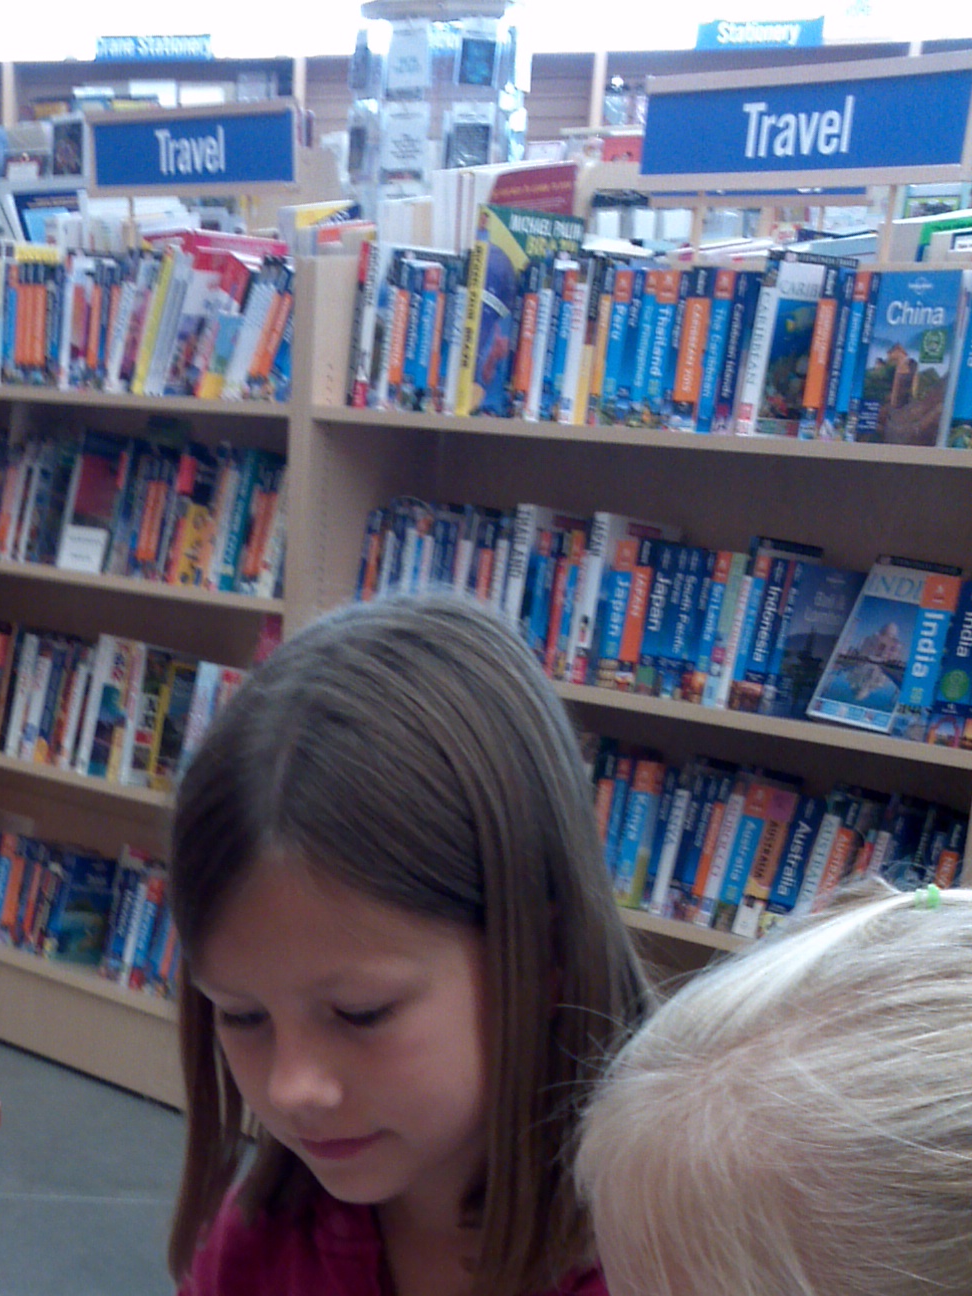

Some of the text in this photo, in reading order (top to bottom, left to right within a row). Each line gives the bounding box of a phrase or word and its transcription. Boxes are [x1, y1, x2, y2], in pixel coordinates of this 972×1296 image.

[137, 36, 210, 58] Stationery
[717, 22, 802, 46] Stationery
[154, 124, 226, 176] Travel
[742, 94, 856, 159] Travel
[509, 212, 584, 241] MICHAEL PALIN
[780, 278, 822, 298] CARIB
[886, 300, 945, 326] China
[611, 304, 626, 341] Peru
[650, 305, 673, 378] Thailand
[721, 303, 745, 398] Caribbean Islands
[746, 290, 771, 385] CARIBBEAN
[848, 310, 862, 354] Jamaica
[862, 303, 876, 344] Jamaica
[703, 308, 727, 398] The Caribbean
[509, 510, 533, 579] THAILAND
[590, 518, 607, 557] JAPAN
[608, 575, 631, 637] Japan
[630, 572, 647, 617] JAPAN
[647, 571, 673, 632] Japan
[672, 574, 698, 654] South Pacific
[702, 582, 725, 642] Sri Lanka
[866, 573, 924, 602] INDI
[752, 585, 784, 663] Indonesia
[911, 611, 945, 678] India
[956, 611, 972, 658] India
[624, 794, 648, 841] Kenya
[731, 820, 757, 883] Australia
[754, 819, 777, 879] AUSTRALIA
[776, 819, 812, 897] Australia
